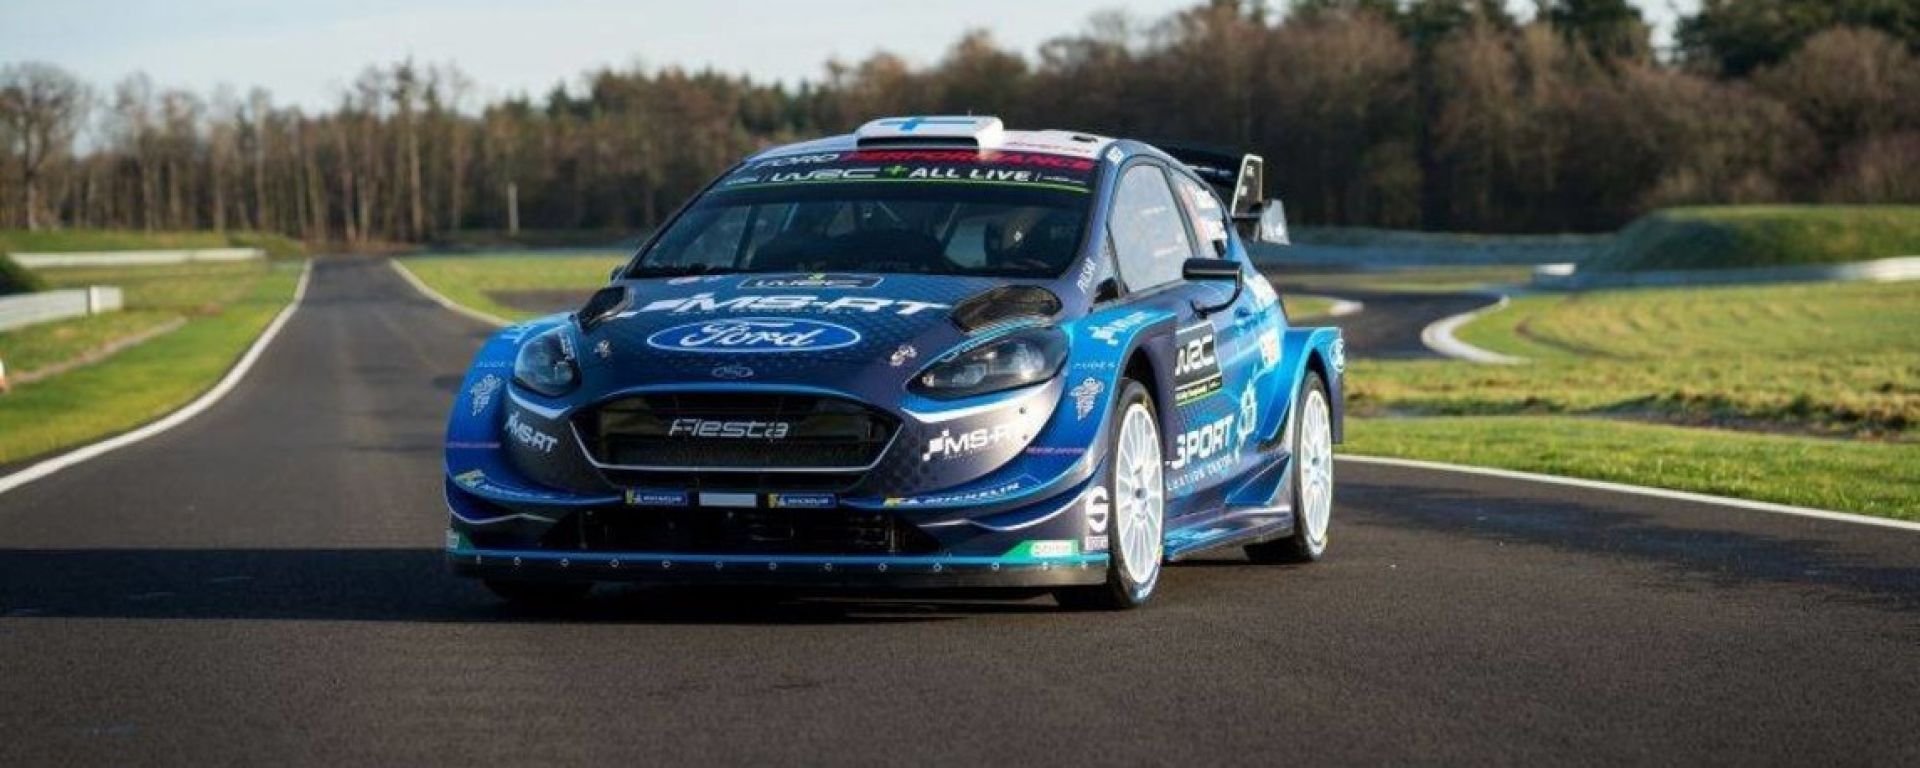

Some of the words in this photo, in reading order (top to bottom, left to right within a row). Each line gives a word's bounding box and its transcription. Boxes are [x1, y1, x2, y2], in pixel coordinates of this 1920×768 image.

[908, 167, 960, 180] ALL
[968, 168, 1032, 182] LIVE
[679, 322, 827, 347] Ford
[668, 418, 789, 439] Fiesta
